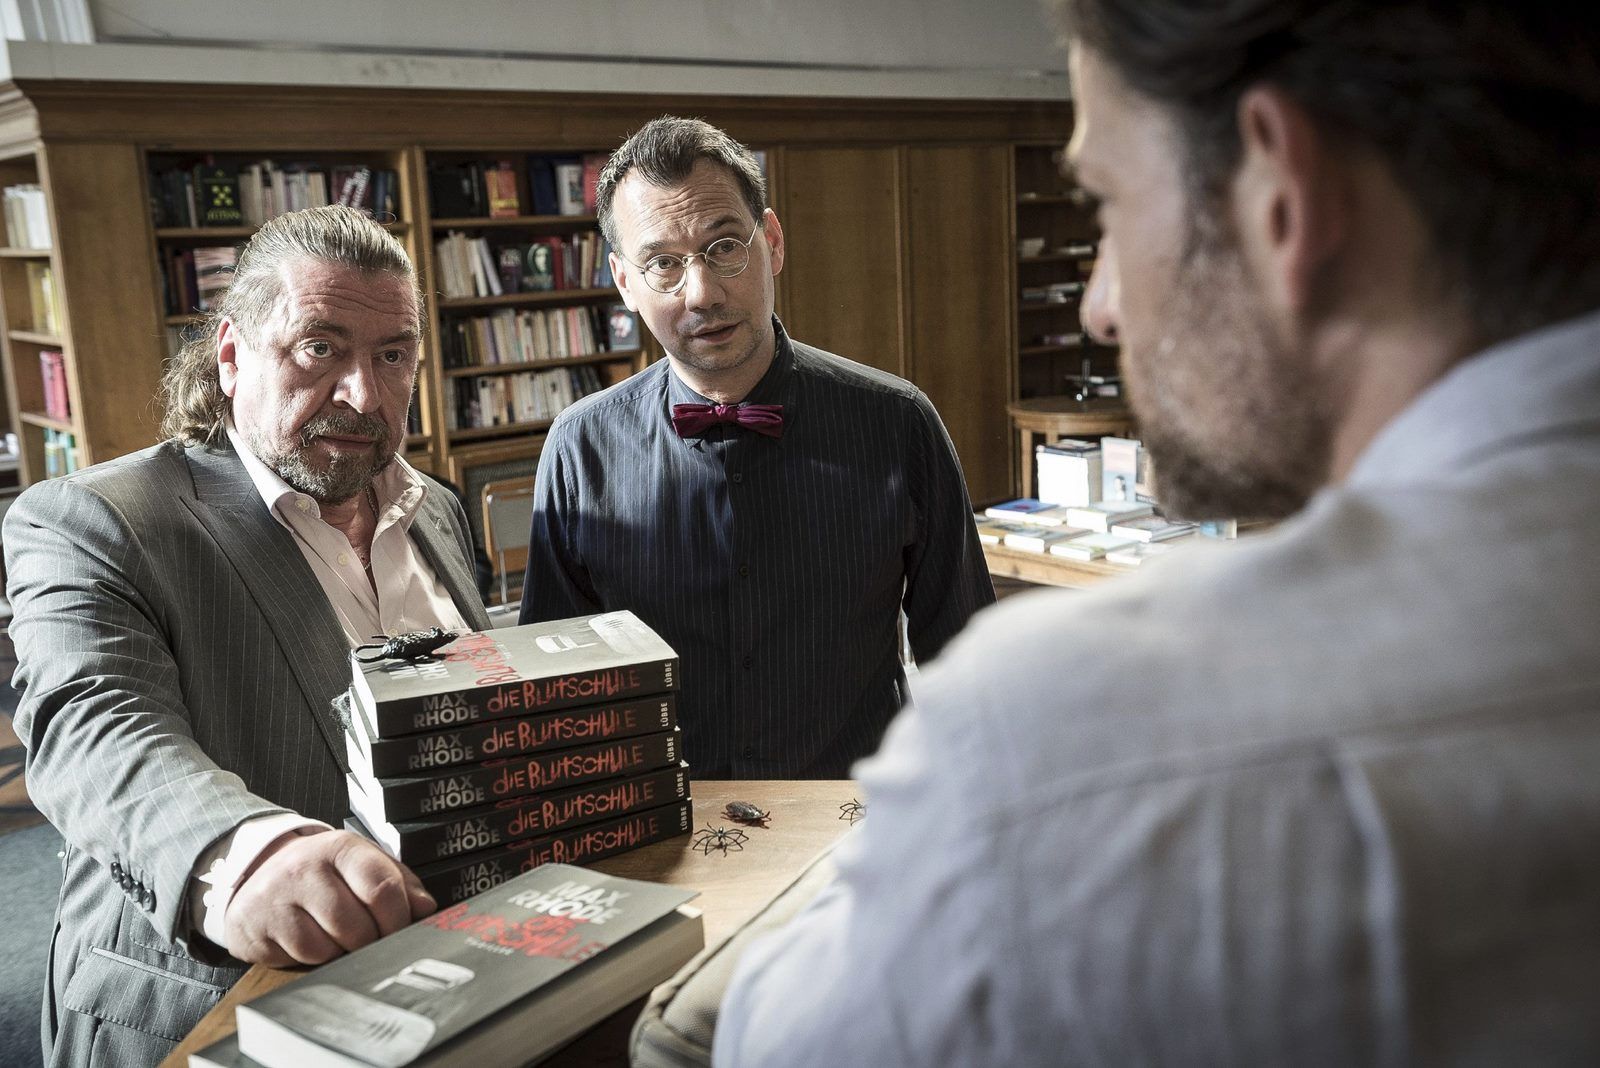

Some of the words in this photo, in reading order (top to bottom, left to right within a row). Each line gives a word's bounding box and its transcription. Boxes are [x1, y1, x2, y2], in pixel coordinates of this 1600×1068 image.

[423, 692, 468, 711] MAX
[413, 704, 479, 728] RHODE
[417, 733, 462, 752] MAX
[408, 746, 475, 769] RHODE
[429, 775, 473, 796] MAX
[420, 787, 485, 813] RHODE
[446, 817, 489, 838] MAX
[437, 828, 500, 856] RHODE
[460, 860, 501, 882] MAX
[549, 880, 629, 906] MAX
[508, 889, 622, 924] RHODE
